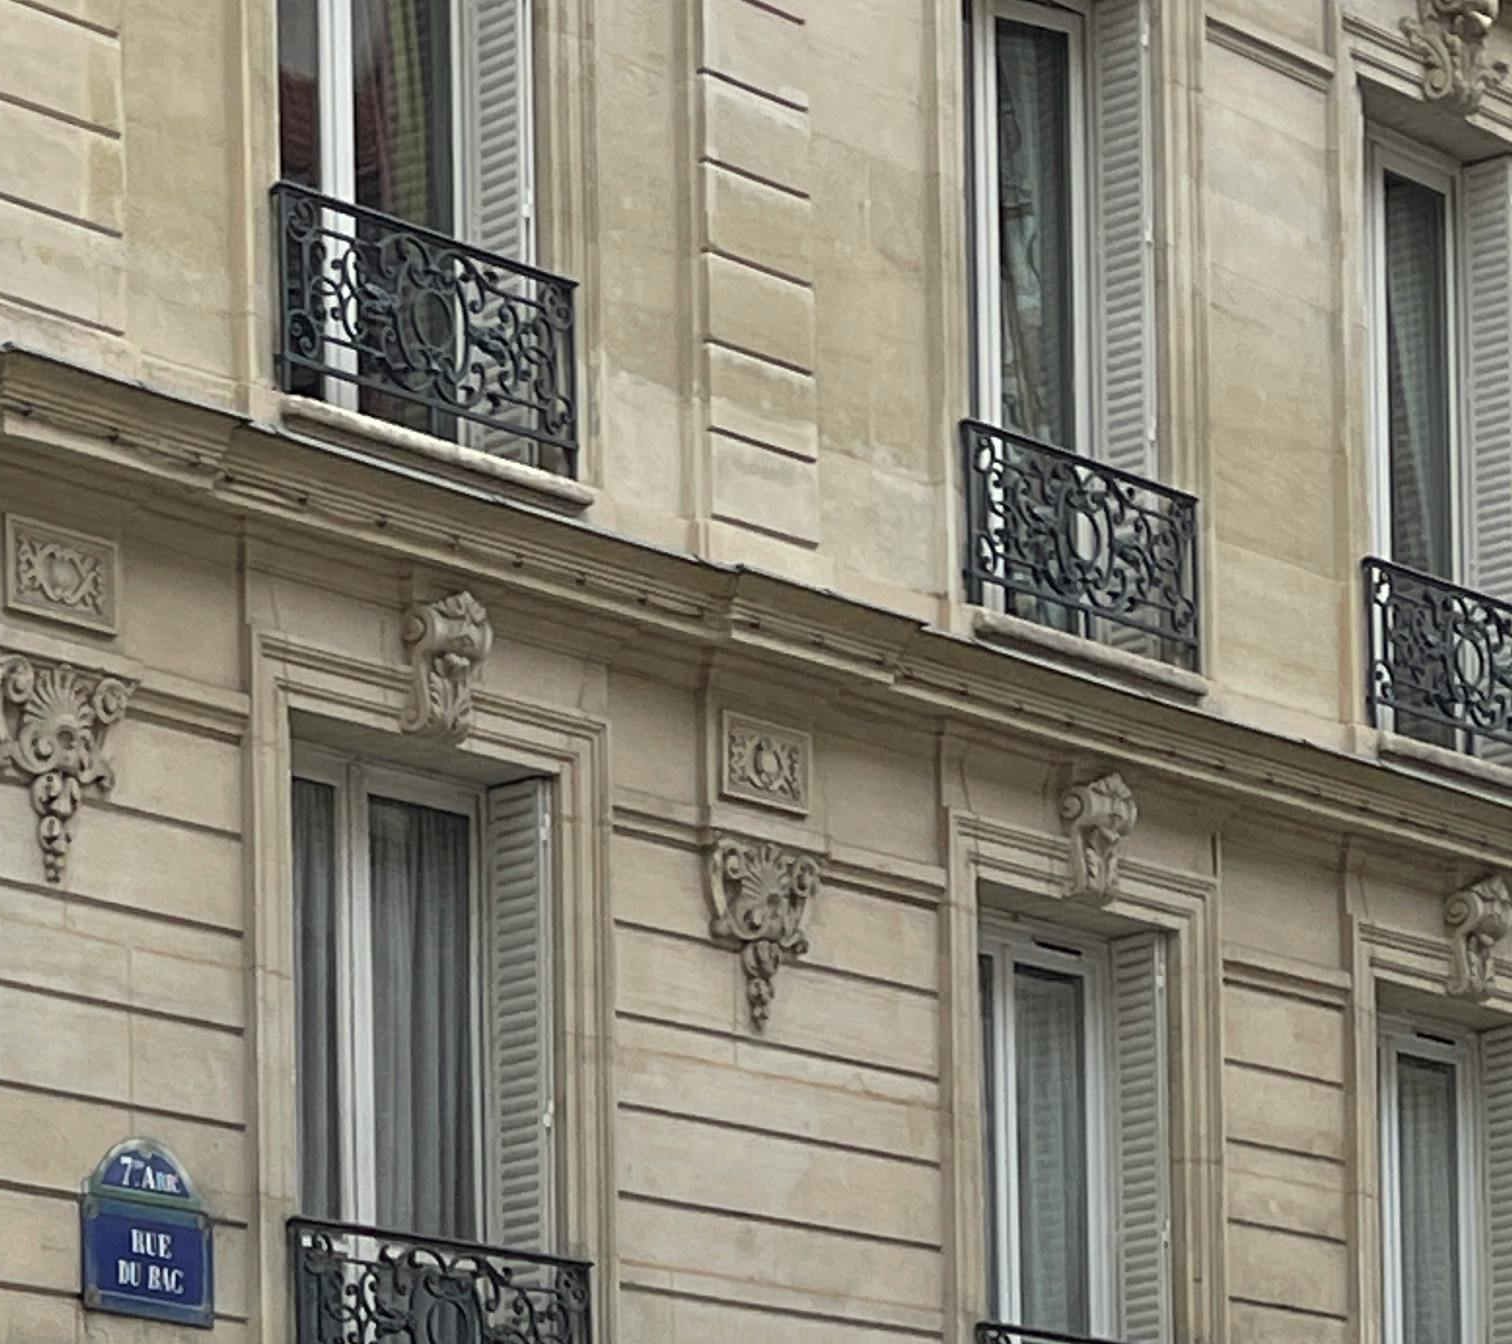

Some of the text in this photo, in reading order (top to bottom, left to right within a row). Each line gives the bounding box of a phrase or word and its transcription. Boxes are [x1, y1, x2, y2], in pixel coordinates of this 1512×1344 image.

[131, 1229, 173, 1260] RUE
[117, 1259, 185, 1295] DU BAC
